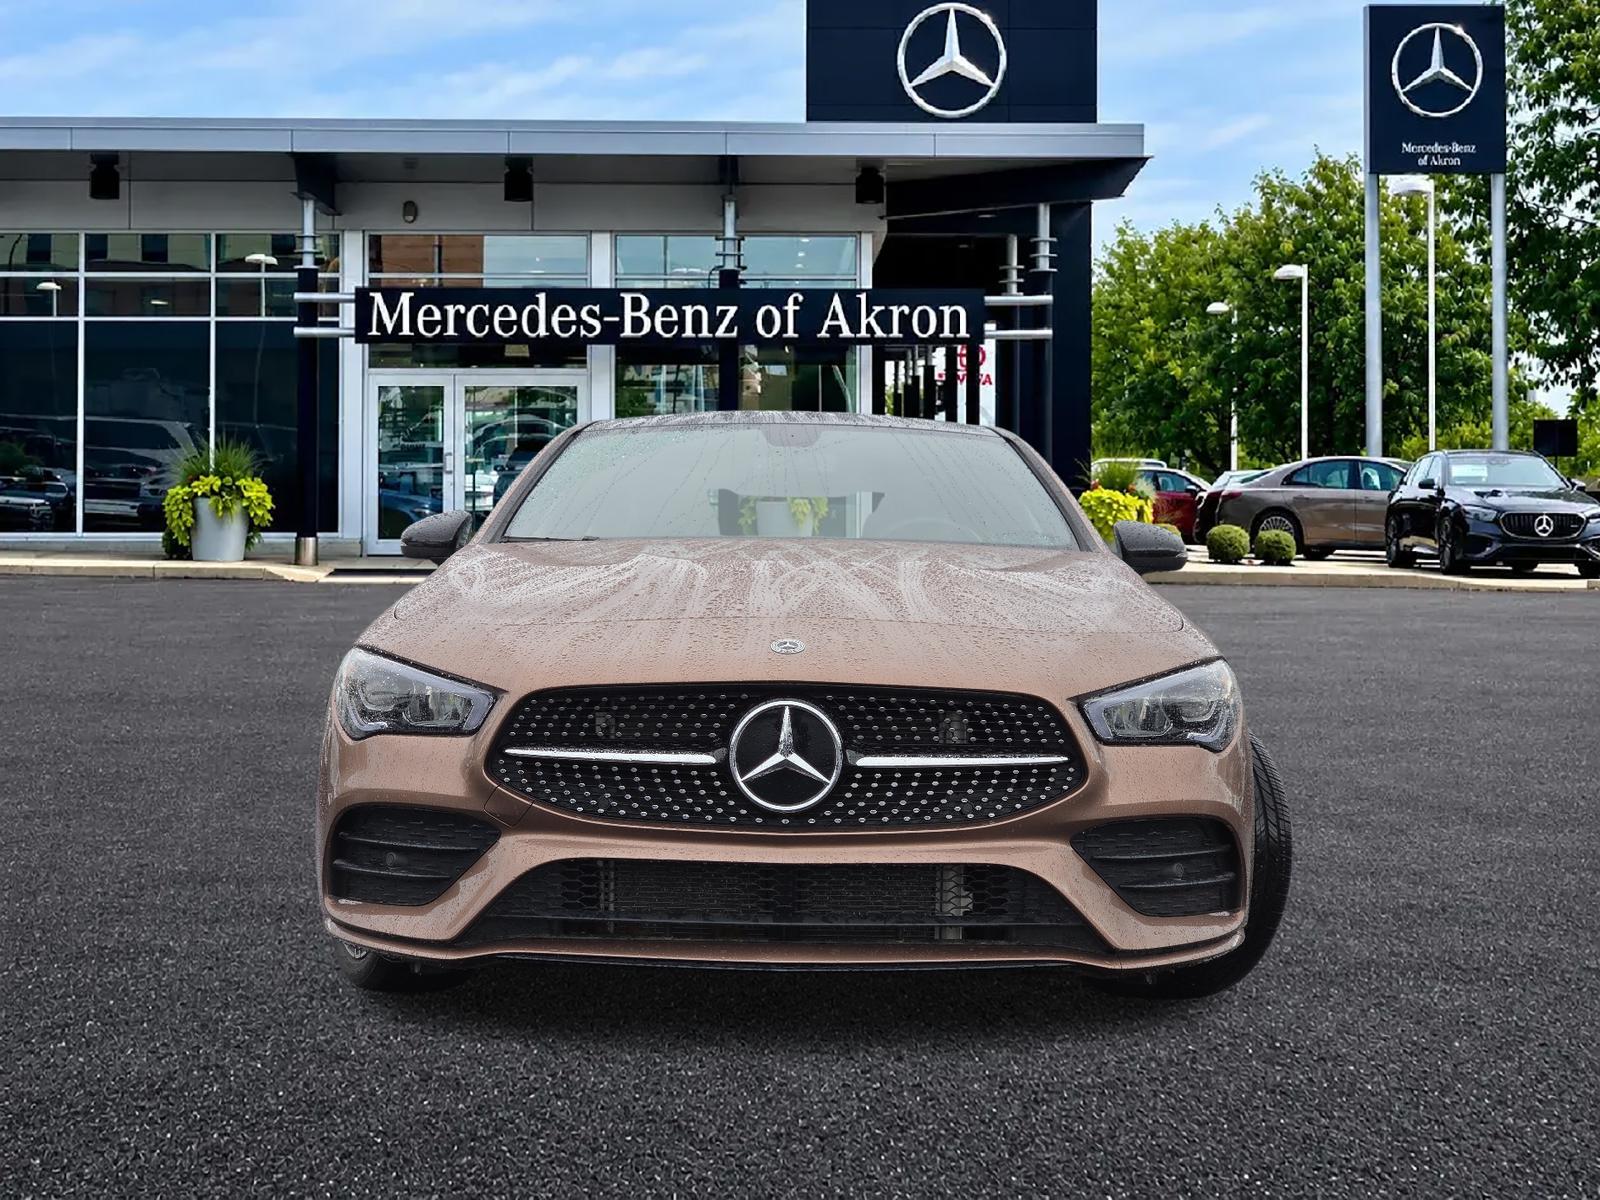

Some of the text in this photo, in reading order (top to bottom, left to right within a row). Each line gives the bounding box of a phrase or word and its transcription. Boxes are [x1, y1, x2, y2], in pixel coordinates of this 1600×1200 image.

[1401, 142, 1476, 153] Mercedes-Benz
[1417, 155, 1461, 166] of Akron
[367, 292, 970, 338] Mercedes-Benz of Akron
